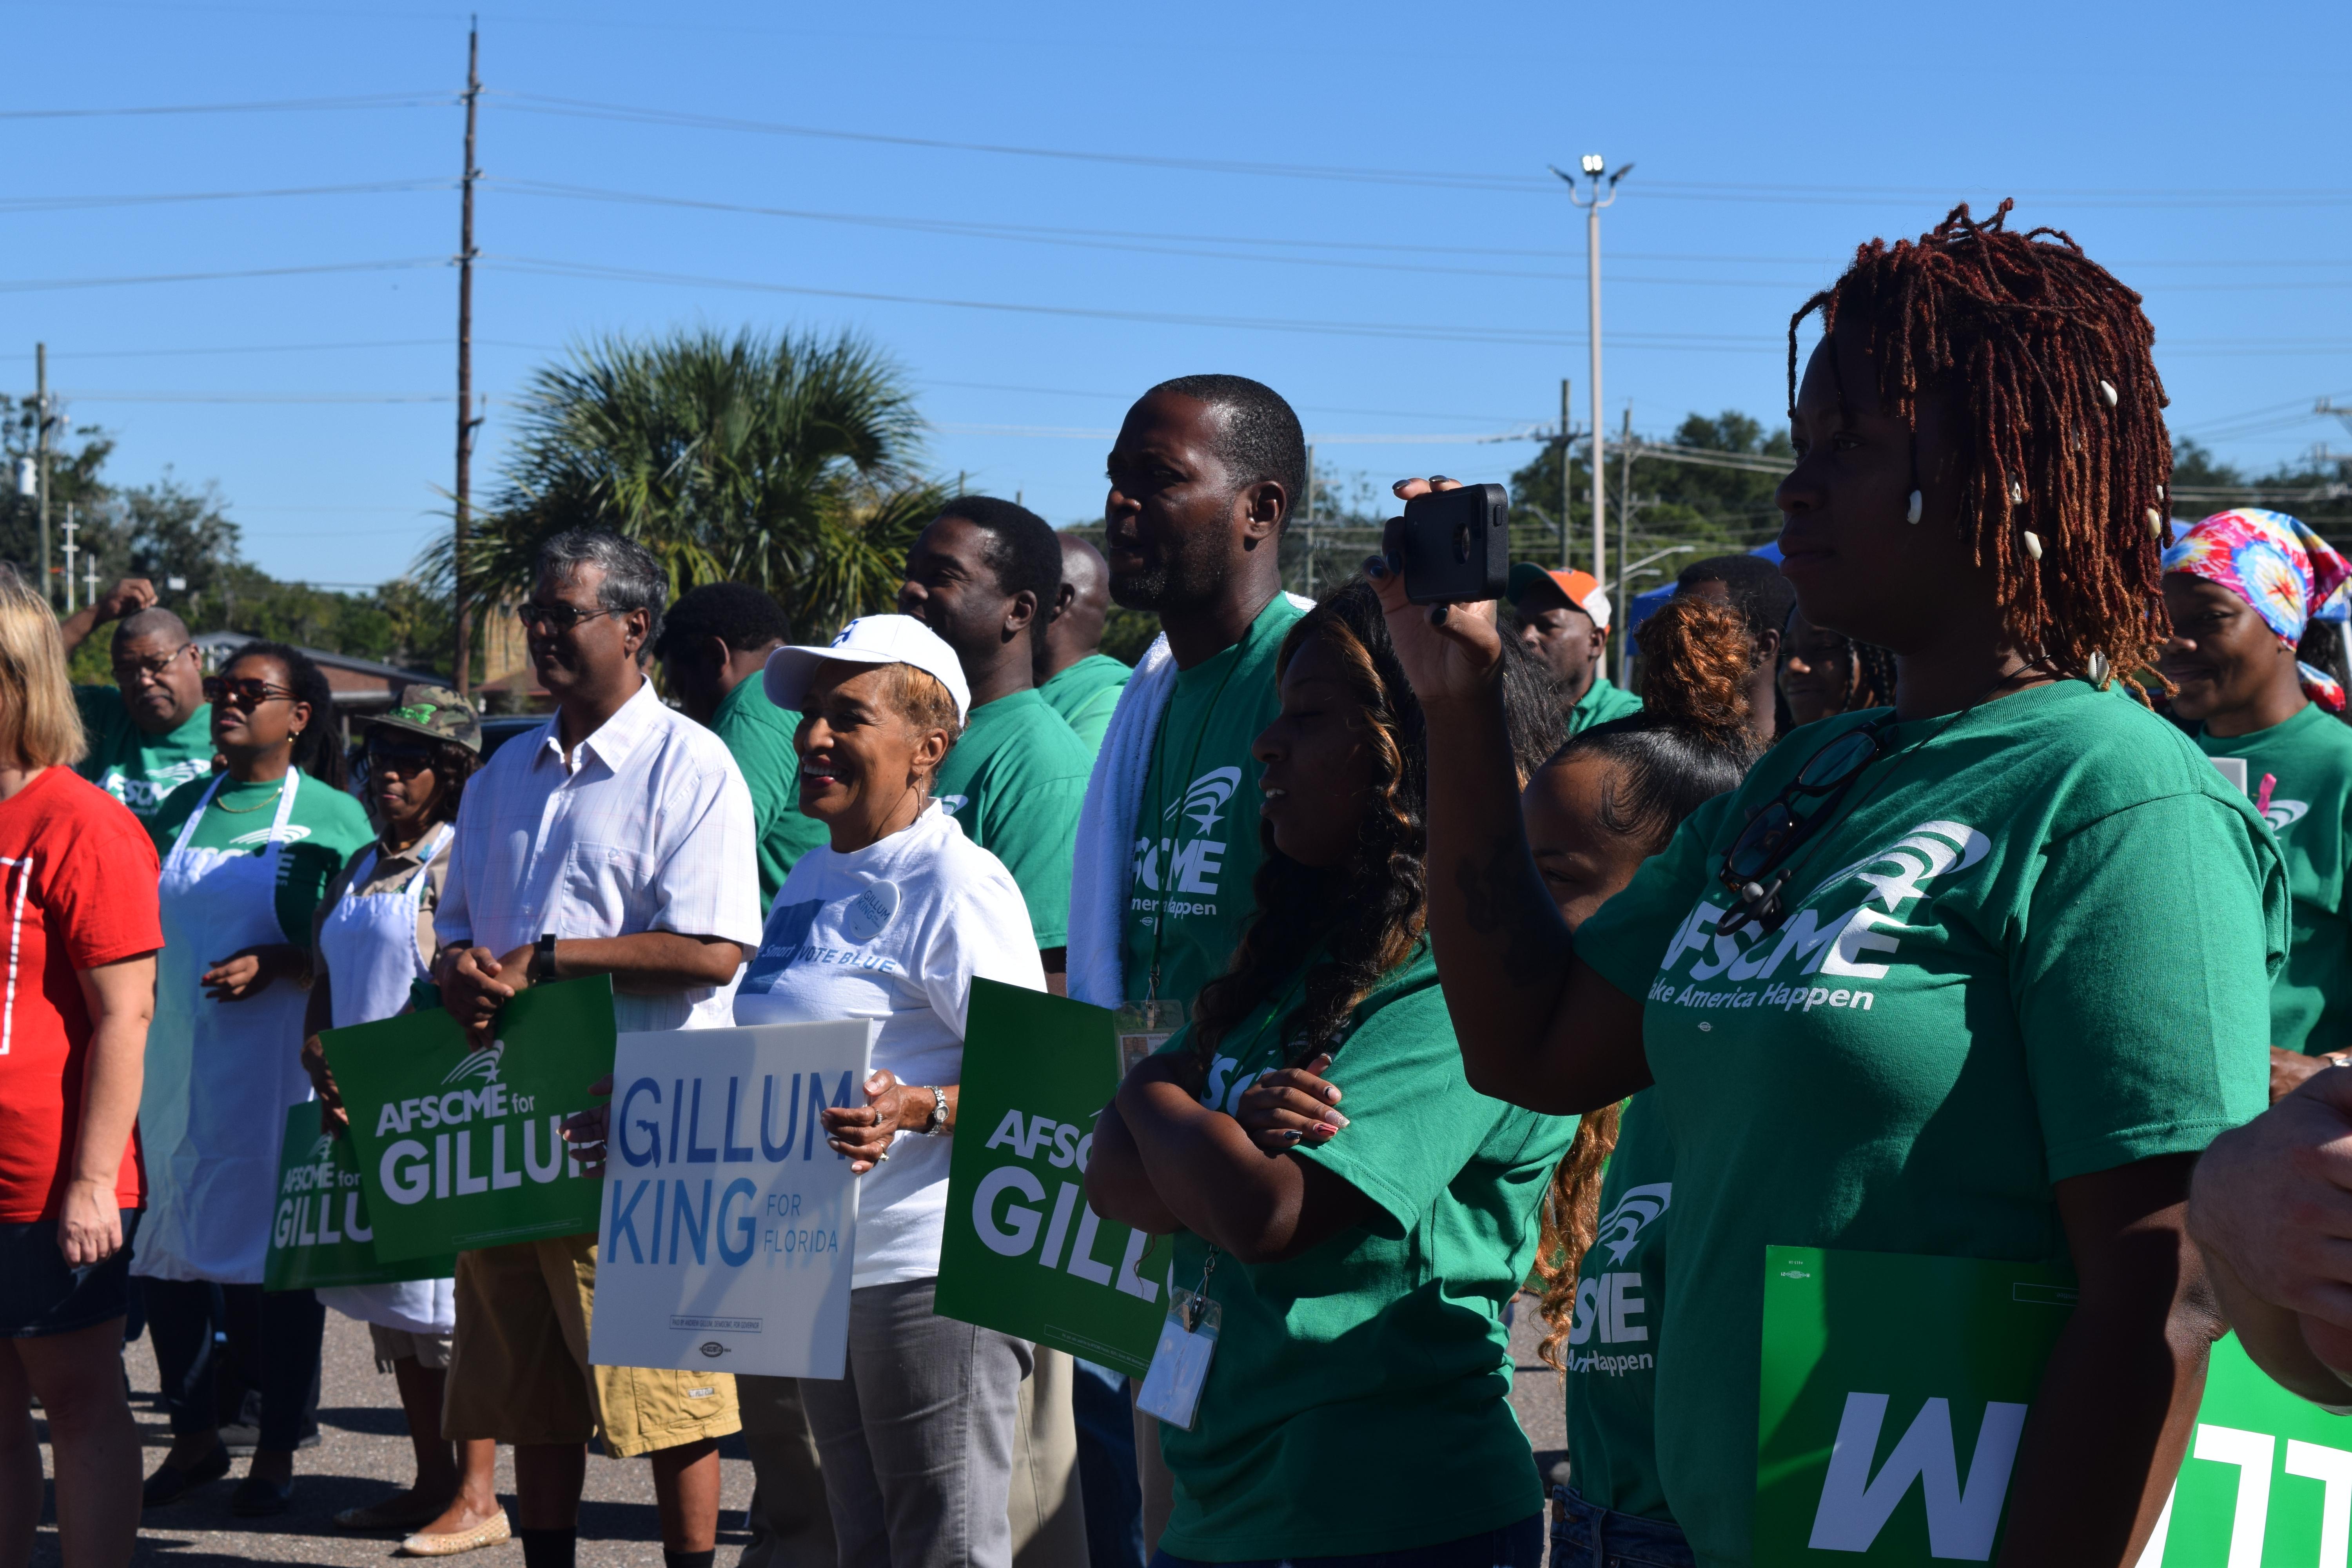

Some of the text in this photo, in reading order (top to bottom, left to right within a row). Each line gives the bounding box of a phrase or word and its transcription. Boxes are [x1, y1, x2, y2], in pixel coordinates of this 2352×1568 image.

[856, 898, 875, 919] KING
[864, 890, 890, 920] GILLUM
[762, 944, 797, 957] Smart
[798, 946, 838, 963] VOTE
[838, 952, 897, 975] BLUE
[1661, 901, 1900, 979] FSCME
[1648, 976, 1874, 1012] ake America Happen
[376, 1083, 534, 1137] AFSCME for
[619, 1071, 853, 1168] GILLUM
[985, 1109, 1093, 1174] AFSC
[281, 1162, 361, 1194] AFSCME for
[275, 1192, 373, 1249] GILLU
[608, 1177, 801, 1267] KING FOR
[764, 1230, 838, 1253] FLORIDA
[972, 1166, 1172, 1303] GILL
[1587, 1350, 1653, 1377] Happen
